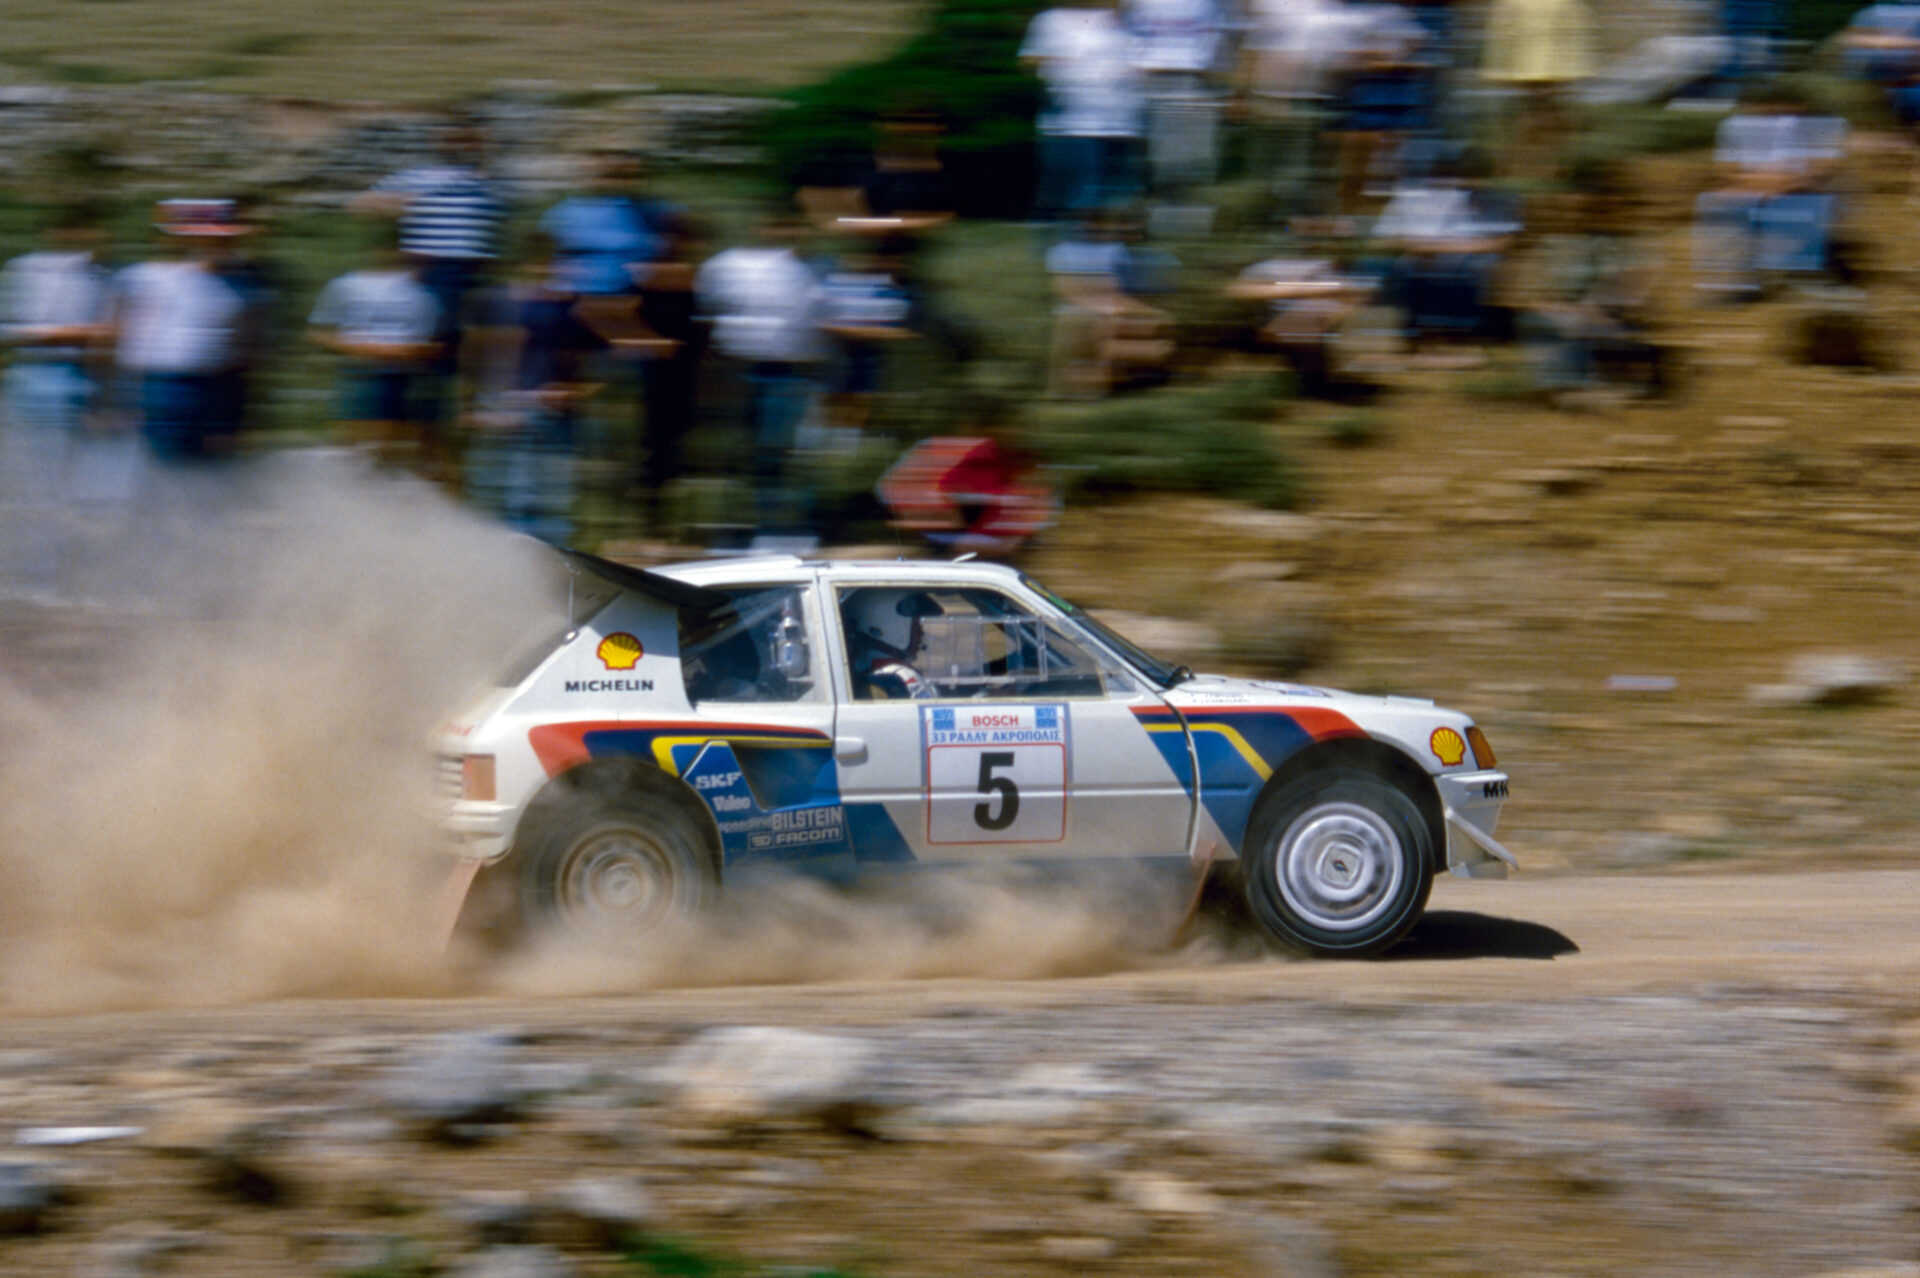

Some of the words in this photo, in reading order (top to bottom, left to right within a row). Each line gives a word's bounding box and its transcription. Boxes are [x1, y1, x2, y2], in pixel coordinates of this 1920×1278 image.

[565, 679, 654, 692] MICHELIN
[972, 715, 1019, 727] BOSCH
[931, 732, 946, 743] 33
[694, 771, 742, 790] SKF
[974, 752, 1020, 831] 5
[772, 806, 842, 831] BILSTEIN
[776, 827, 840, 845] FACOM
